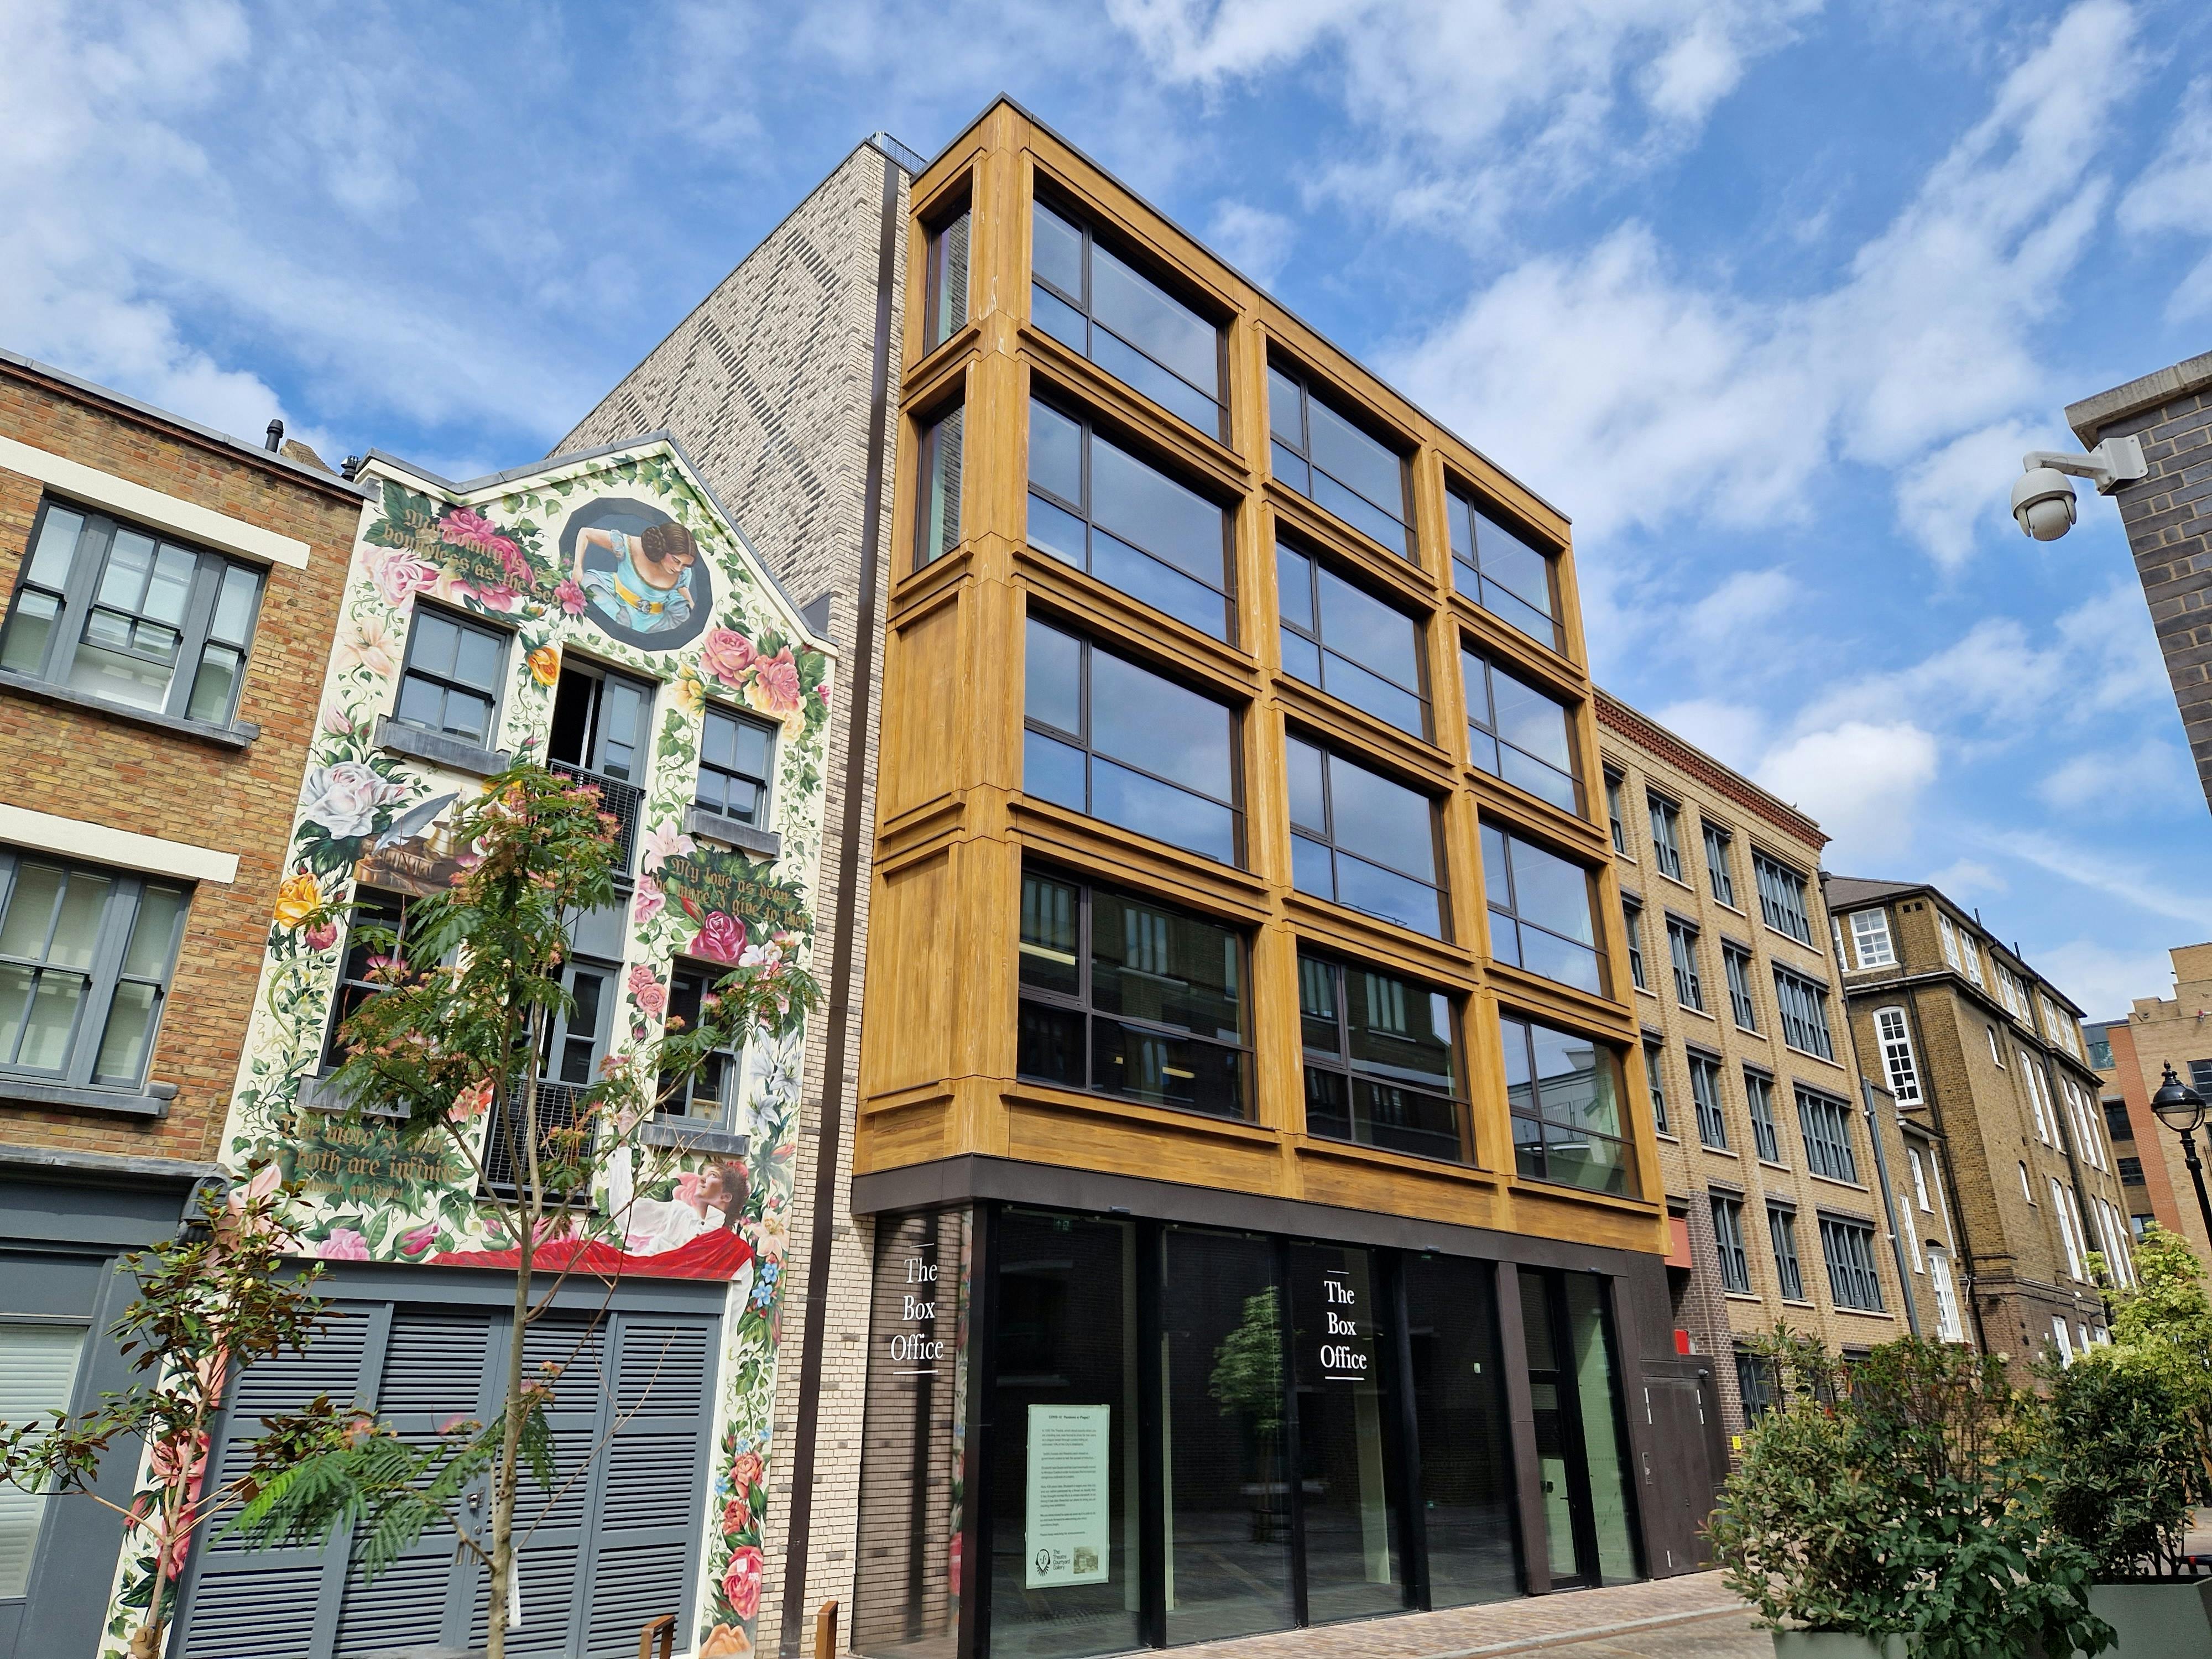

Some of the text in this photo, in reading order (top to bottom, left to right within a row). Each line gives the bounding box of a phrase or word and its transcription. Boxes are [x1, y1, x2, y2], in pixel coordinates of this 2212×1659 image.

[403, 508, 441, 536] My
[447, 526, 503, 565] bounty
[384, 523, 562, 607] boundless as the sea
[669, 858, 699, 883] My
[705, 867, 732, 889] love
[738, 880, 754, 895] as
[649, 873, 670, 894] the
[678, 884, 710, 904] more
[732, 897, 759, 917] give
[764, 905, 778, 921] to
[783, 909, 808, 930] thee
[278, 1113, 322, 1142] The
[325, 1125, 375, 1147] more
[295, 1147, 342, 1177] both
[347, 1156, 380, 1177] are
[389, 1155, 461, 1185] infinite
[349, 1182, 369, 1196] and
[904, 1257, 938, 1284] The
[1324, 1280, 1355, 1305] The
[902, 1295, 935, 1321] Box
[1327, 1311, 1357, 1336] Box
[890, 1333, 944, 1361] Office
[1320, 1344, 1368, 1370] Office
